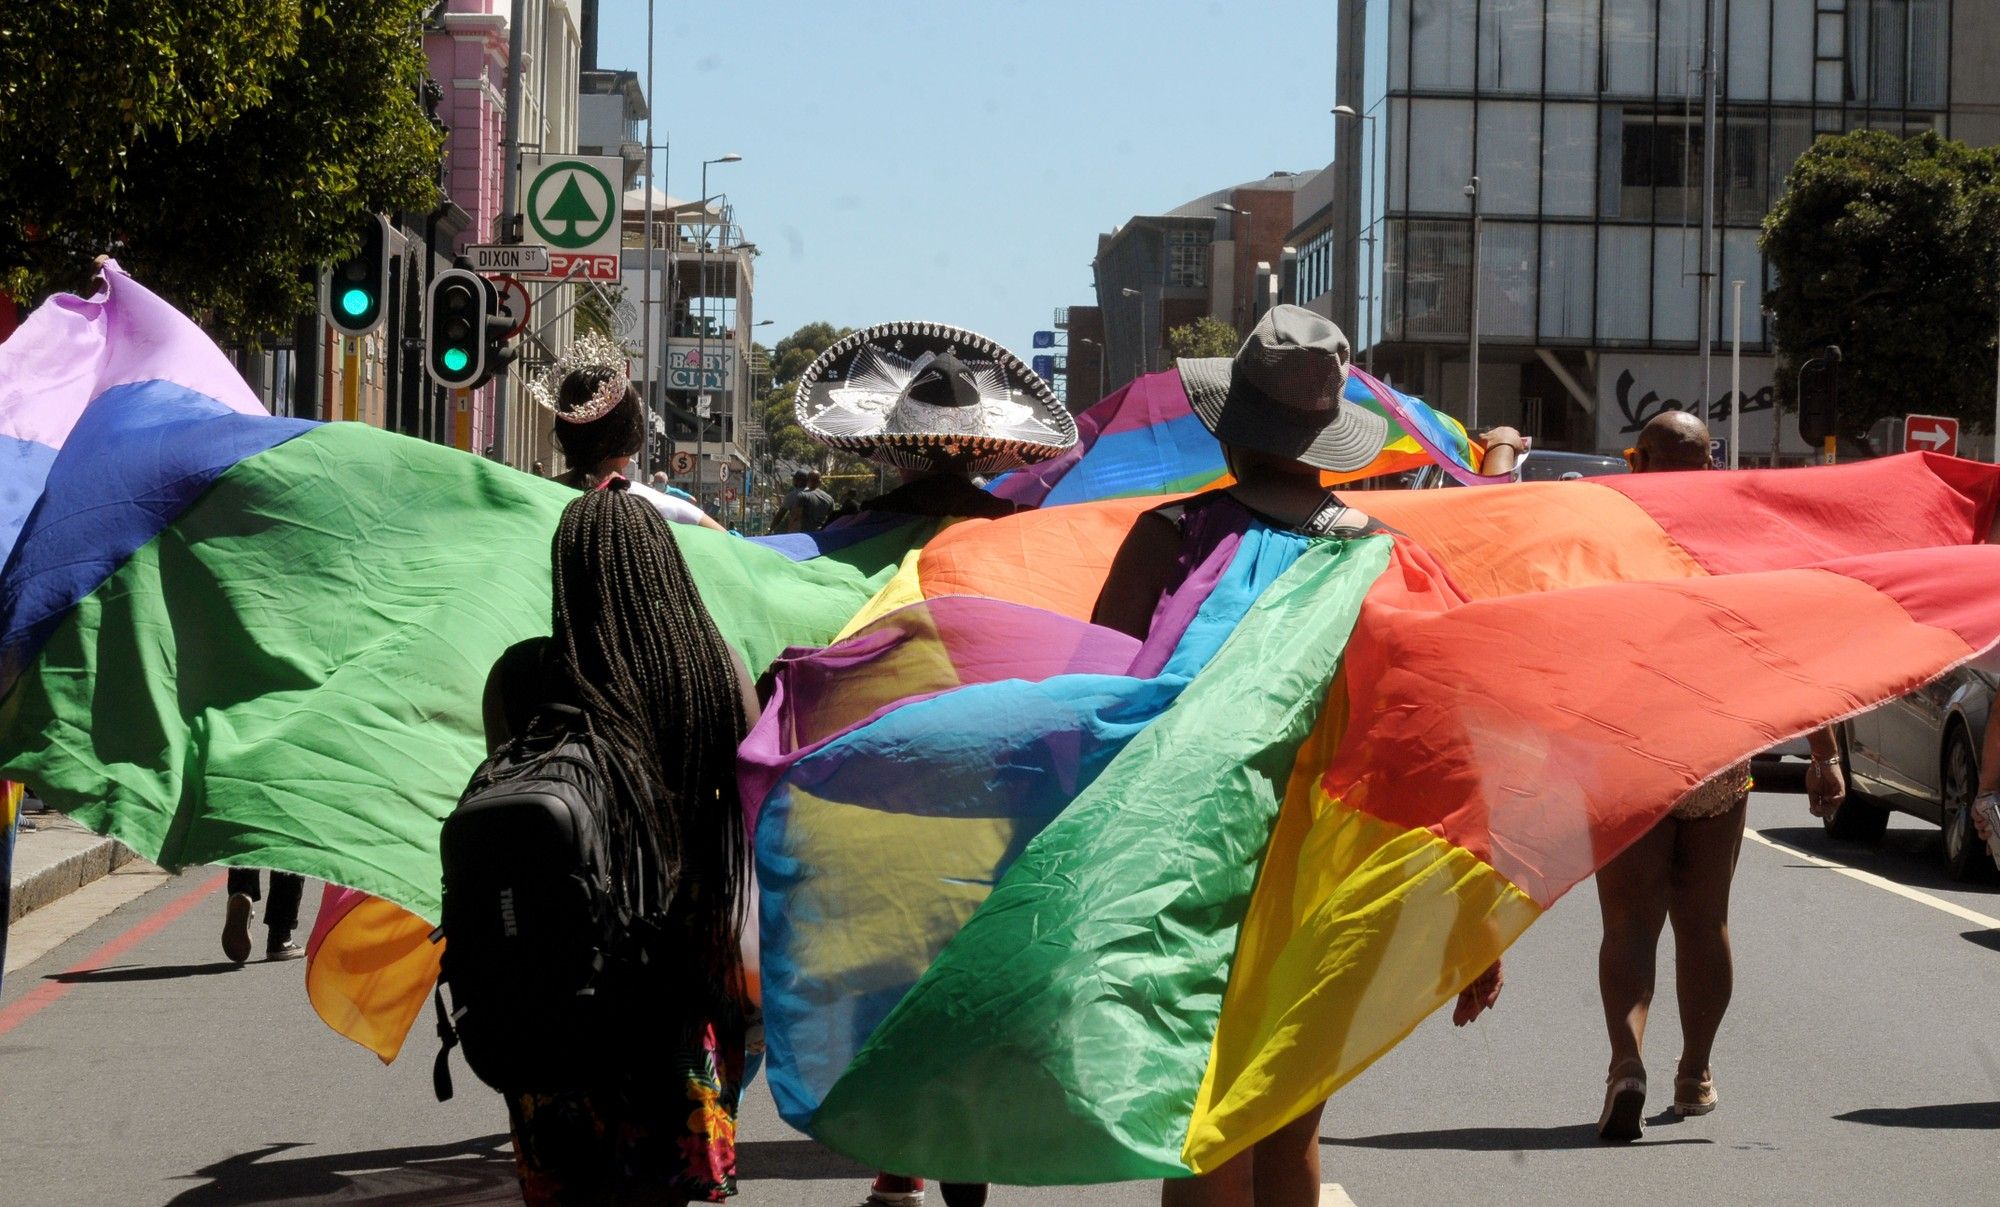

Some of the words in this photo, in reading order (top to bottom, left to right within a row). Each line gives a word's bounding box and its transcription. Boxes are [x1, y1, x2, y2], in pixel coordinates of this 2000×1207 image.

[480, 250, 519, 267] DIXON
[525, 251, 536, 261] ST
[549, 256, 614, 276] PAR
[348, 341, 355, 353] 4
[669, 352, 731, 370] BBY
[671, 370, 729, 388] CITY
[460, 399, 466, 410] 1
[500, 887, 518, 937] THULE
